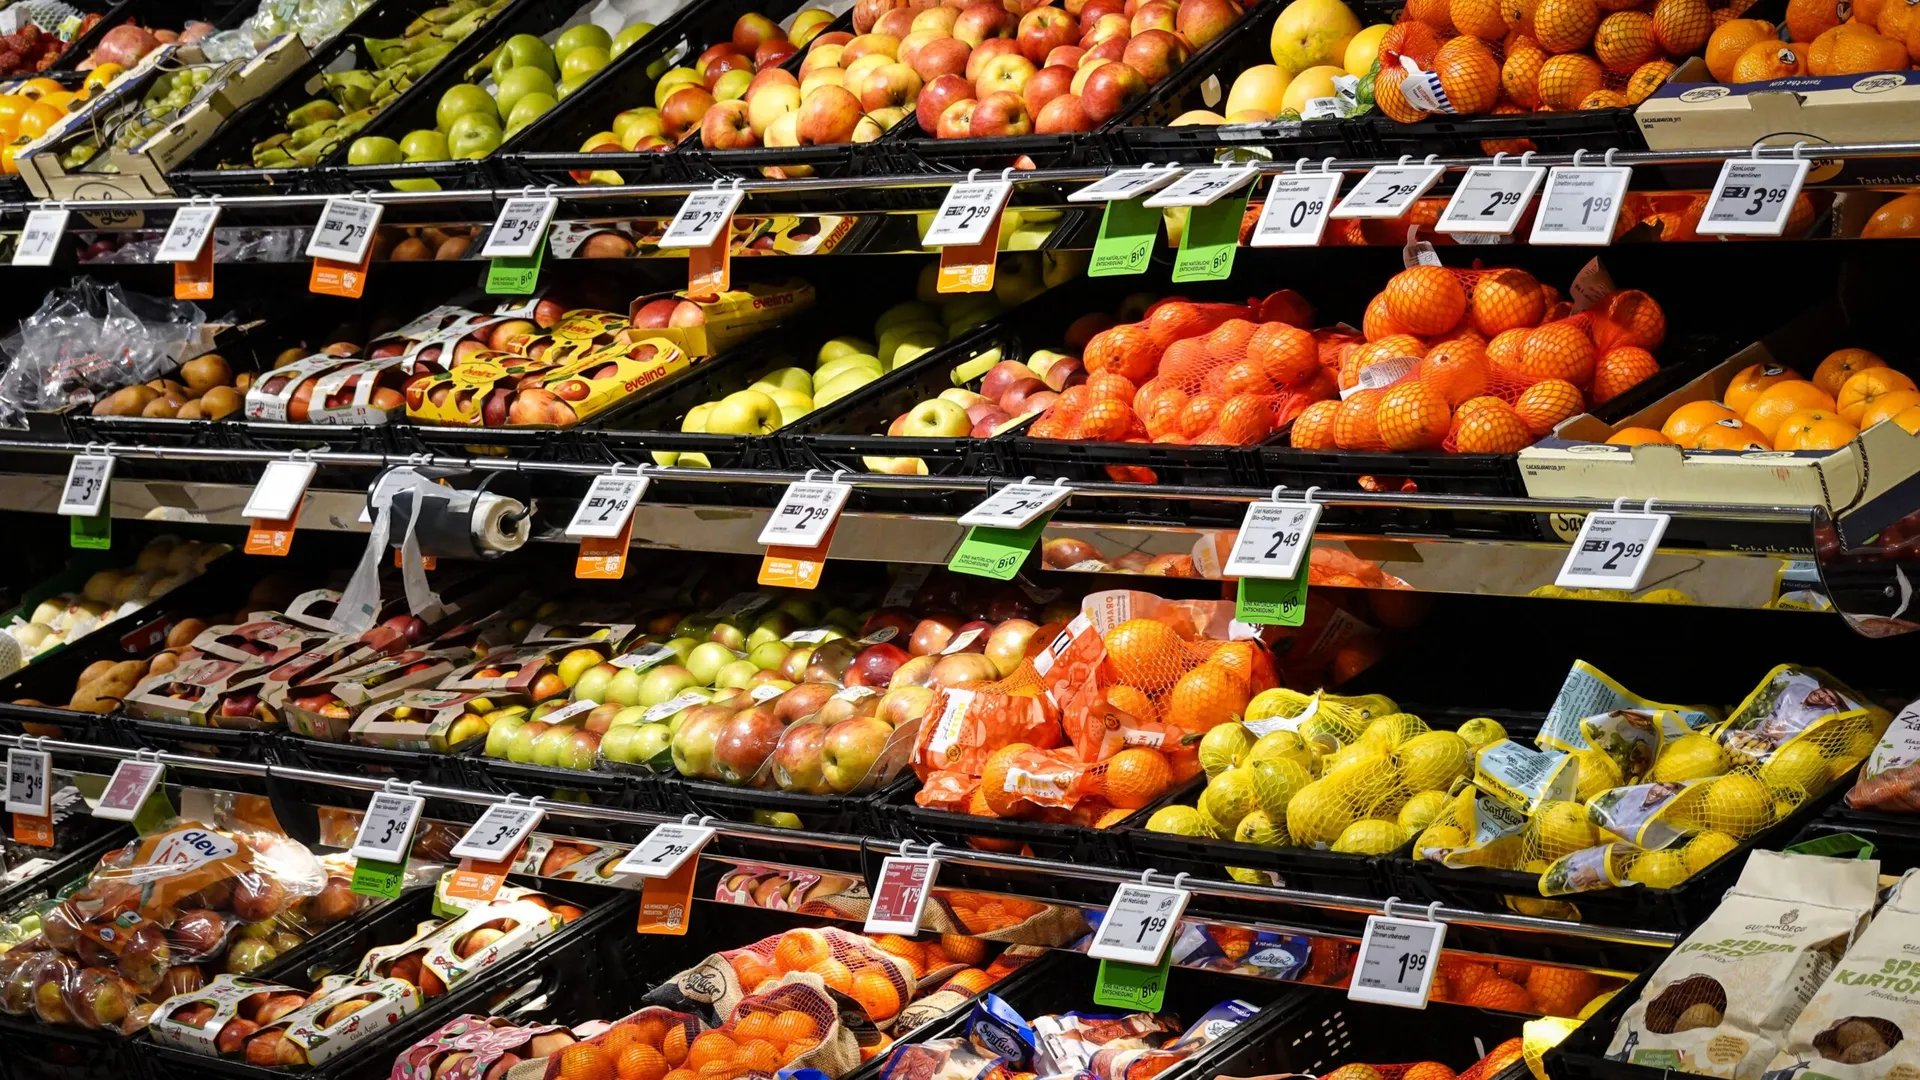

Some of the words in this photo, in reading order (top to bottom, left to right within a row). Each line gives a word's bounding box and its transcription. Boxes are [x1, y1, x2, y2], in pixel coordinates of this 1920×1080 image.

[752, 292, 794, 310] evelina
[624, 365, 667, 394] evelina
[1482, 799, 1522, 826] SanLucar
[183, 831, 232, 858] clev
[979, 1023, 1019, 1058] SanLucar
